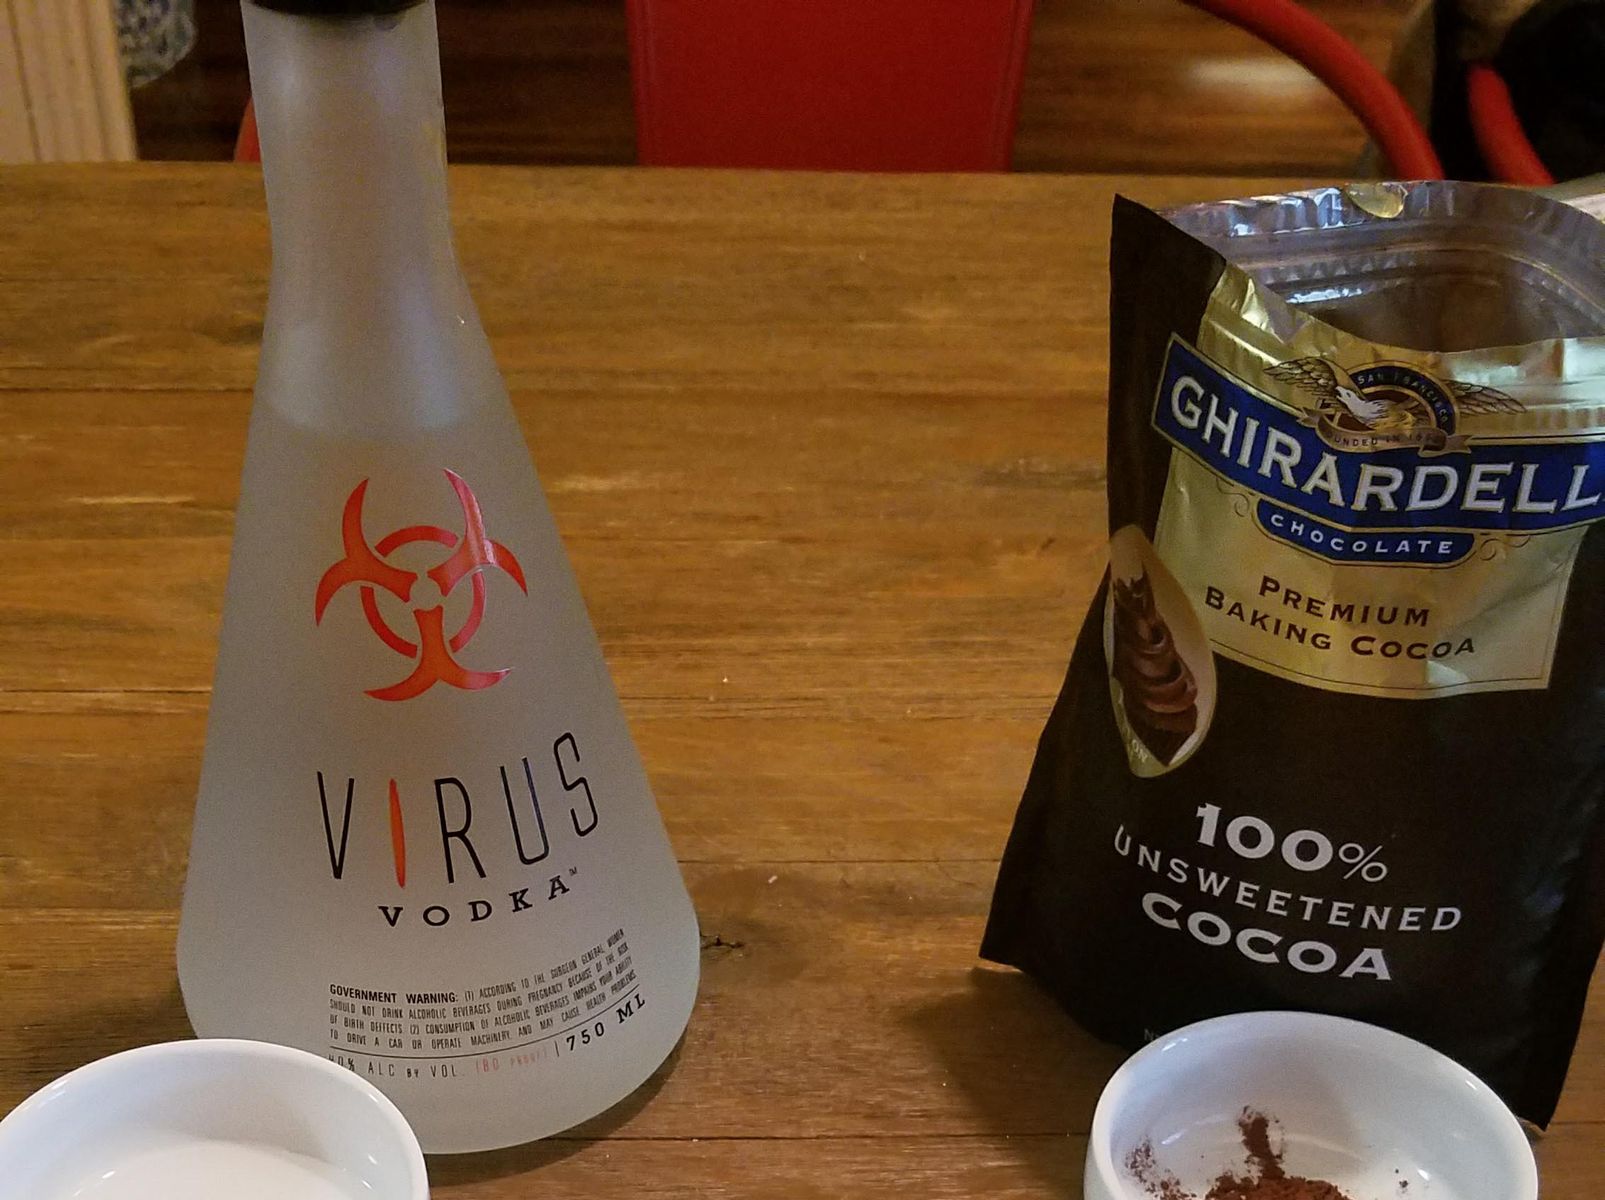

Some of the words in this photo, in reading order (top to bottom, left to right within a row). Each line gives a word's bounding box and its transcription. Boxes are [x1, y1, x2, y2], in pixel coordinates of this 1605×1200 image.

[1170, 373, 1605, 515] GHIRARDELL
[1270, 513, 1453, 554] CHOCOLATE
[1205, 586, 1332, 651] BAKING
[1350, 636, 1476, 660] COCOA
[1258, 575, 1430, 627] PREMIUM
[316, 731, 599, 889] VIRUS
[1196, 802, 1389, 884] 100%
[1113, 824, 1462, 932] UNSWEETENED
[1141, 891, 1392, 981] COCOA
[329, 983, 397, 1003] GOVERNMENT
[405, 991, 459, 1004] WARNING:
[479, 981, 517, 998] ACCORDING
[521, 978, 530, 989] TO
[329, 998, 356, 1014] SHOULD
[361, 1004, 375, 1017] NOT
[382, 1007, 403, 1019] DRINK
[408, 1007, 447, 1020] ALCOHOLIC
[452, 1002, 492, 1018] BEVERAGES
[496, 995, 523, 1012] DURING
[527, 982, 563, 1003] PREGNANCY
[567, 967, 592, 988] BECAUSE
[329, 1013, 338, 1025] OF
[343, 1016, 365, 1030] BIRTH
[425, 1020, 475, 1035] CONSUMPTION
[480, 1018, 489, 1030] OF
[494, 1009, 531, 1027] ALCOHOLIC
[534, 995, 570, 1017] BEVERAGES
[330, 1028, 339, 1040] TO
[346, 1032, 367, 1046] DRIVE
[374, 1036, 380, 1047] A
[388, 1037, 403, 1049] CAR
[411, 1039, 423, 1050] OR
[431, 1037, 462, 1050] OPERATE
[518, 1024, 533, 1038] AND
[539, 1017, 554, 1031] MAY
[561, 1006, 580, 1022] CAUSE
[367, 1061, 395, 1077] ALC
[406, 1068, 419, 1078] BY
[566, 1021, 605, 1051] 750
[616, 993, 646, 1024] ML
